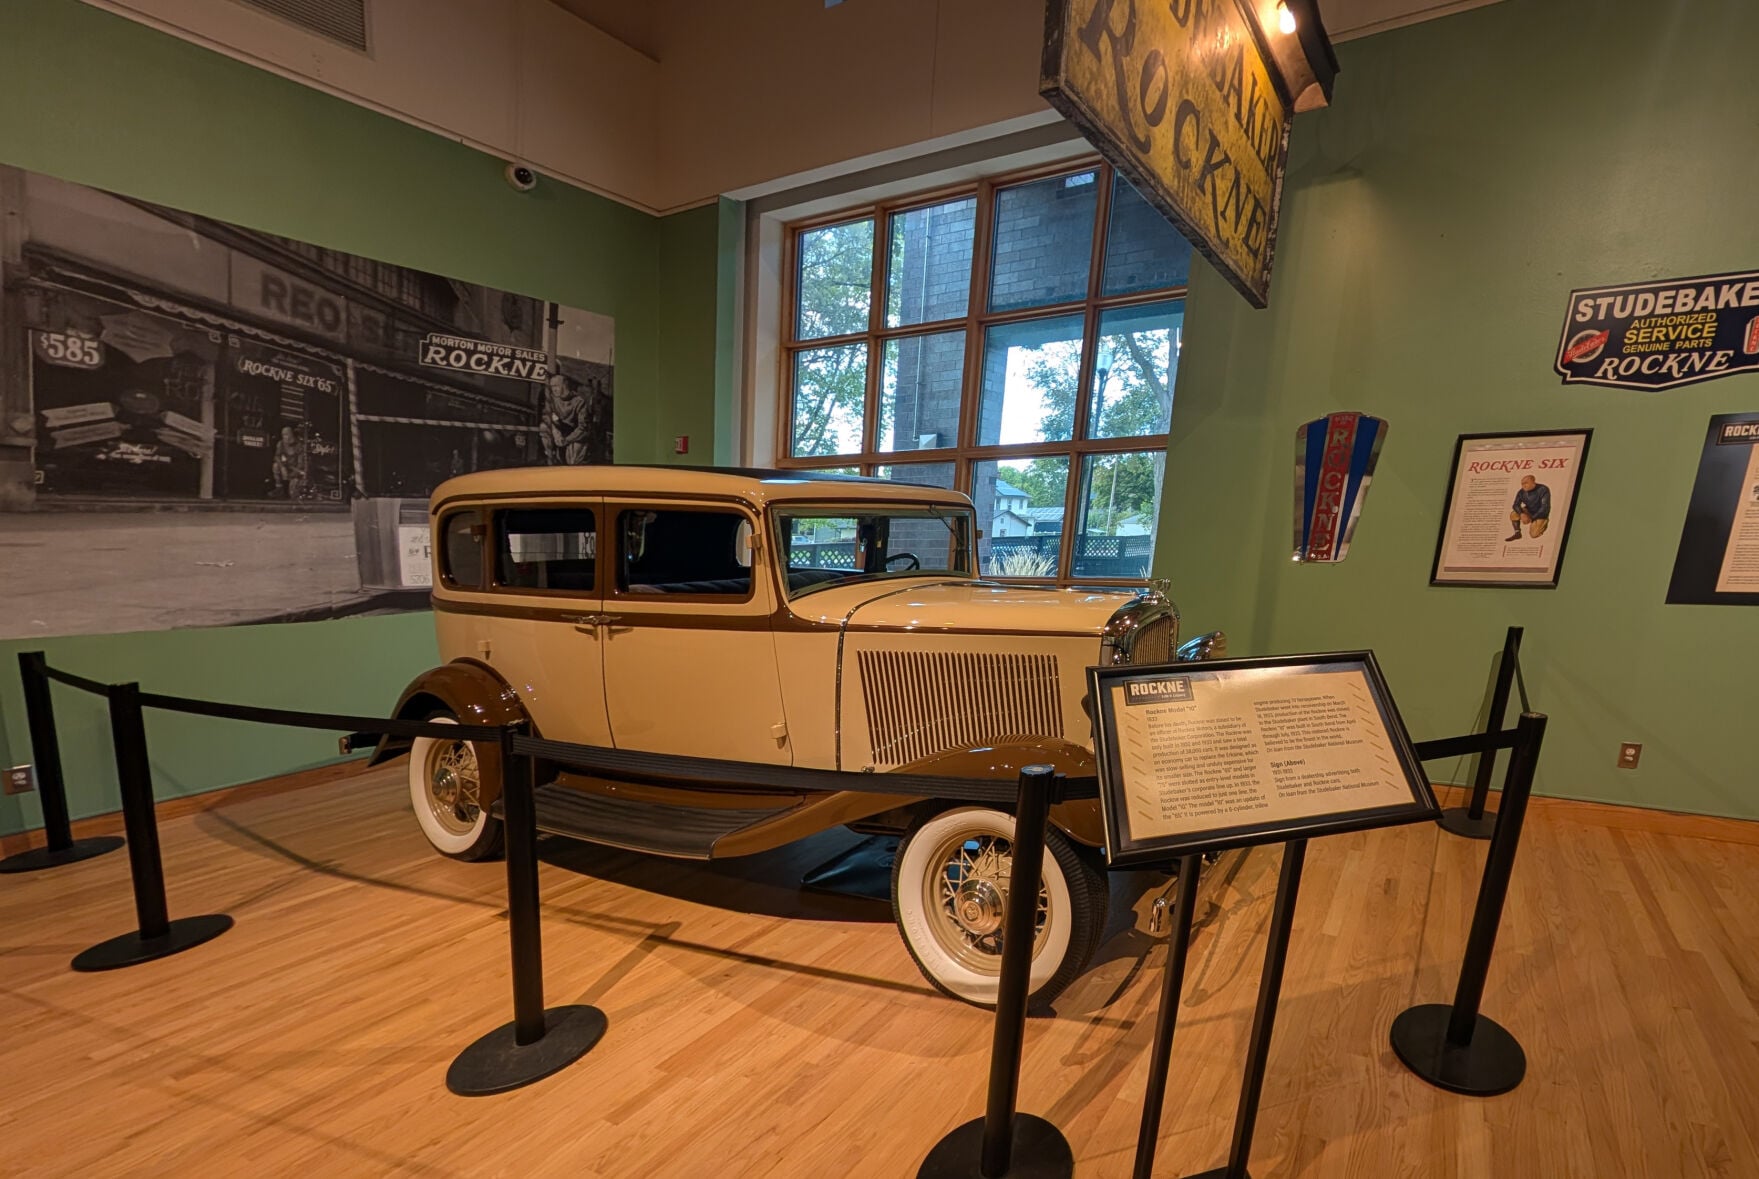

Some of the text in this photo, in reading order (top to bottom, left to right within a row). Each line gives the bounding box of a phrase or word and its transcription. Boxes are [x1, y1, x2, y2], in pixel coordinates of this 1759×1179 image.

[1078, 0, 1267, 259] ROCKNE
[262, 273, 340, 332] REO
[1624, 323, 1718, 344] SERVICE
[1630, 312, 1717, 329] AUTHORIZED
[40, 332, 100, 365] $585
[431, 336, 545, 361] MORTON MOTOR SALES
[1623, 338, 1713, 355] GENUINE PARTS
[243, 360, 294, 381] ROCKNE
[297, 373, 315, 388] SIX
[424, 345, 548, 380] ROCKNE
[1594, 350, 1735, 380] ROCKNE
[1468, 458, 1569, 474] ROCKNE SIX
[1312, 429, 1350, 552] ROCKNE
[1130, 681, 1185, 696] ROCKNE
[1270, 759, 1306, 769] Sign (Above)
